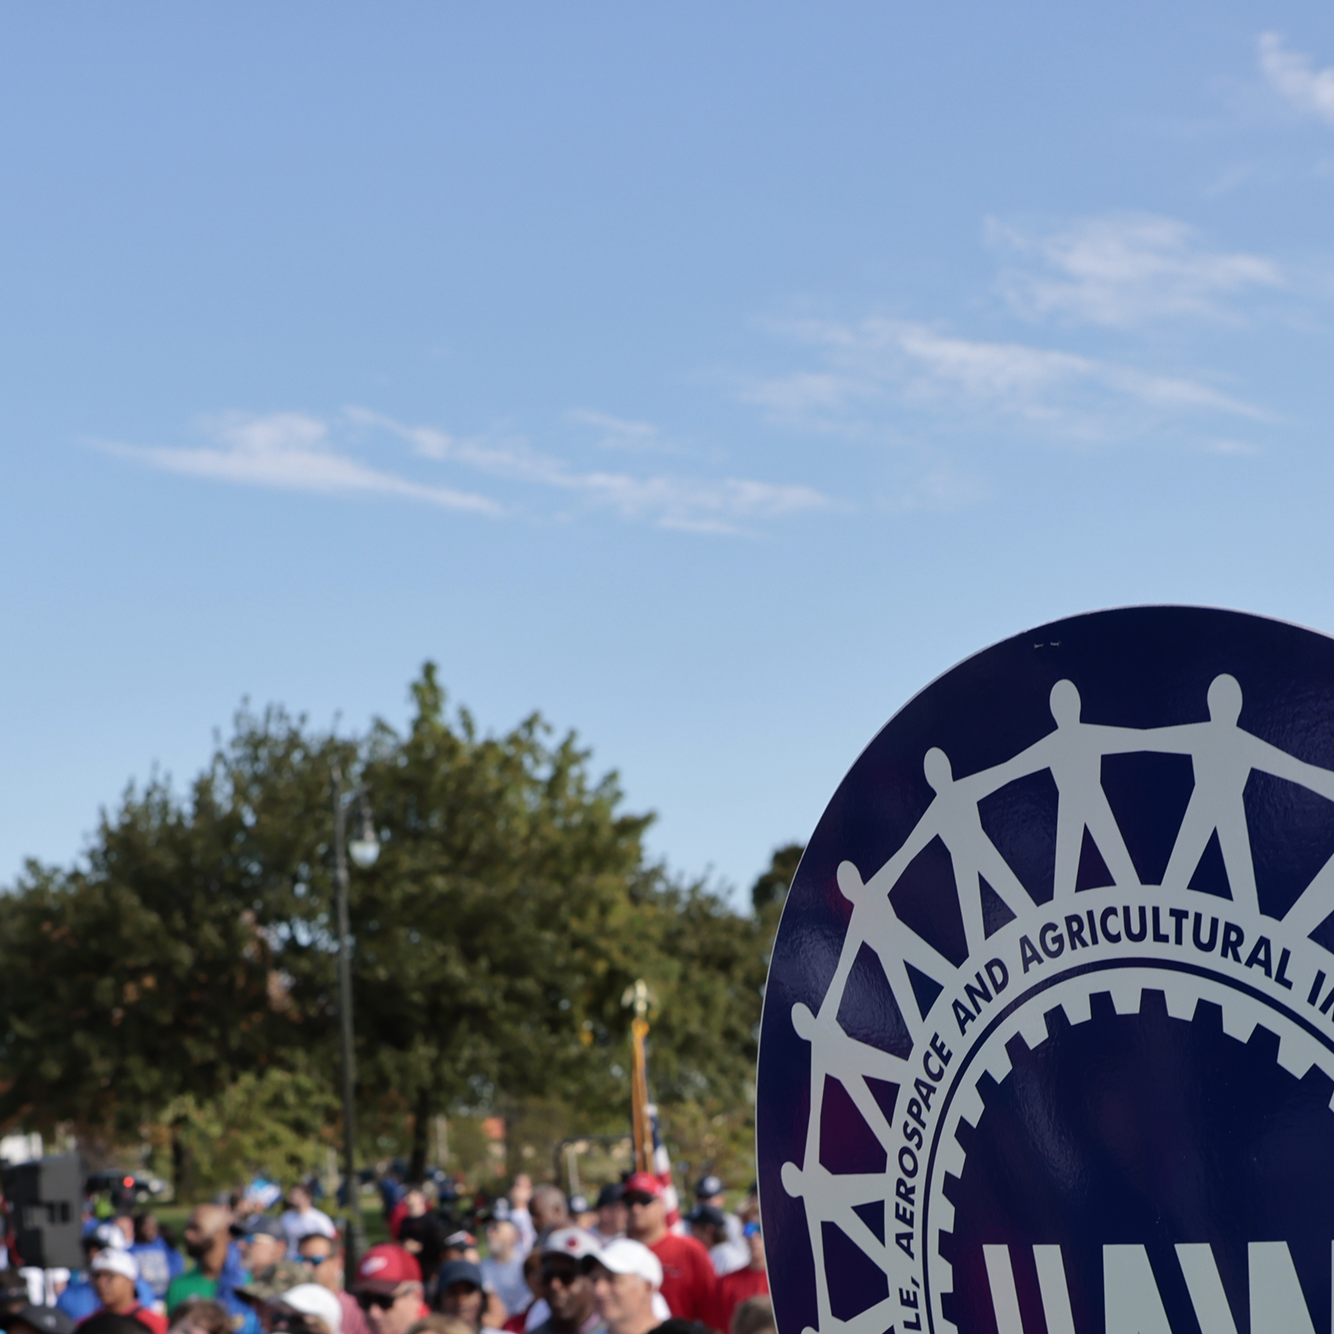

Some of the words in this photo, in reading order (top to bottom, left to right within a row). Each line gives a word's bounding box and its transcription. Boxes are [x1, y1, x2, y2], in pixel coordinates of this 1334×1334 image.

[894, 1031, 954, 1260] AEROSPACE
[951, 957, 1010, 1037] AND
[1018, 905, 1294, 991] AGRICULTURAL
